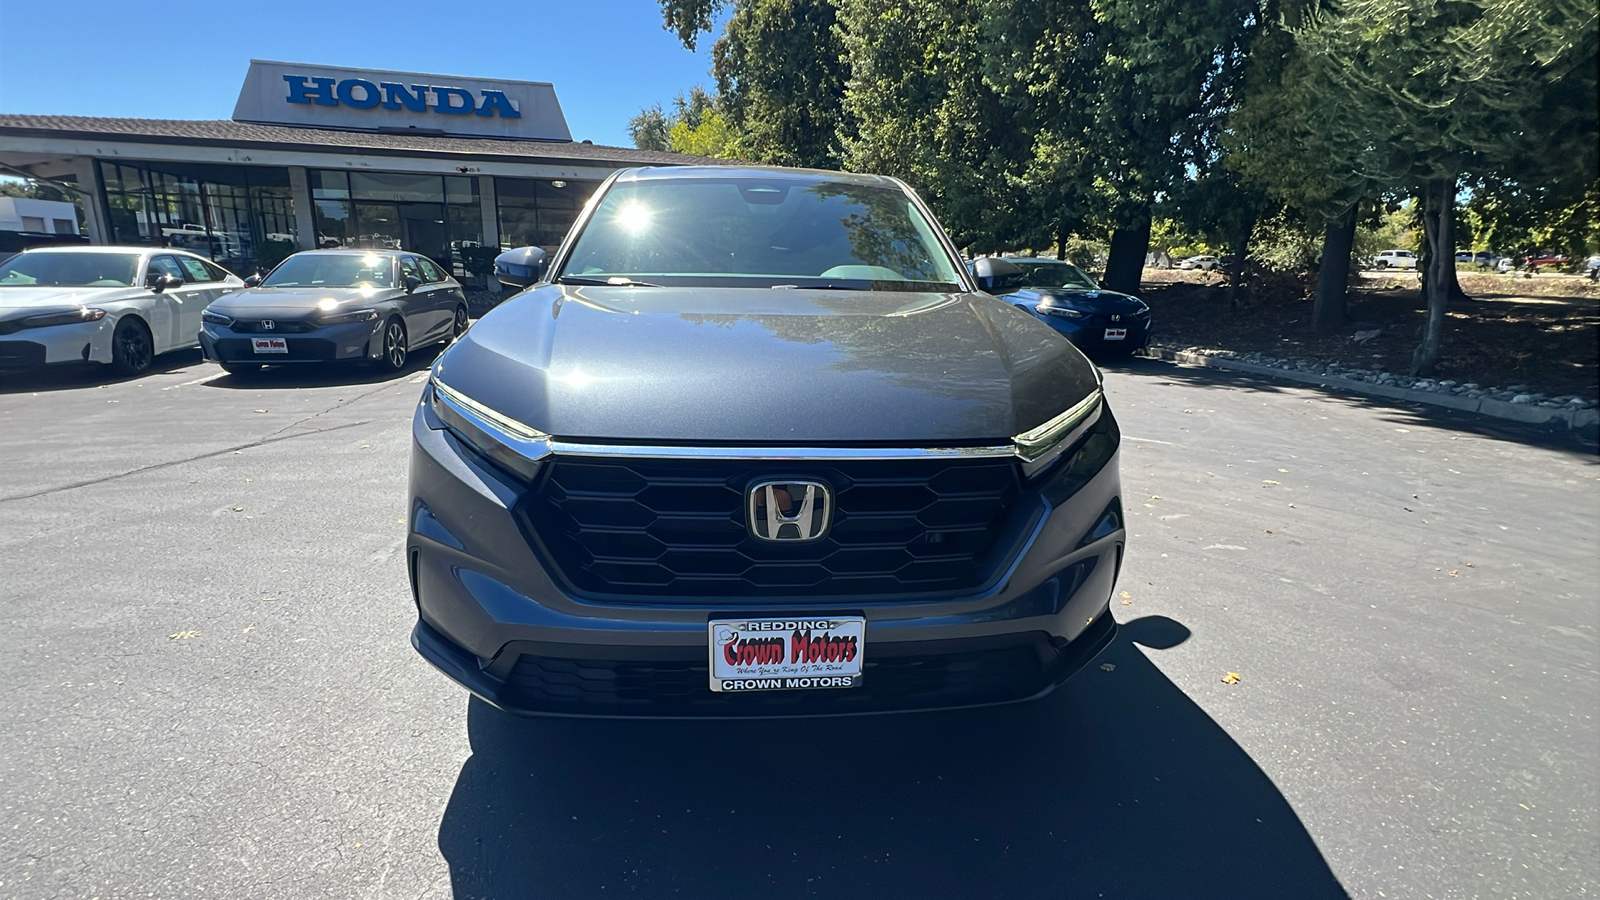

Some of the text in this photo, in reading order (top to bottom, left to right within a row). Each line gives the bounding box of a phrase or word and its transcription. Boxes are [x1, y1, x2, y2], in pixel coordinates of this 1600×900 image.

[283, 74, 521, 118] HONDA
[748, 621, 828, 631] REDDING
[724, 630, 858, 666] Crown Motors
[782, 666, 798, 674] King
[801, 665, 810, 673] Of
[722, 677, 852, 690] CROWN MOTORS
